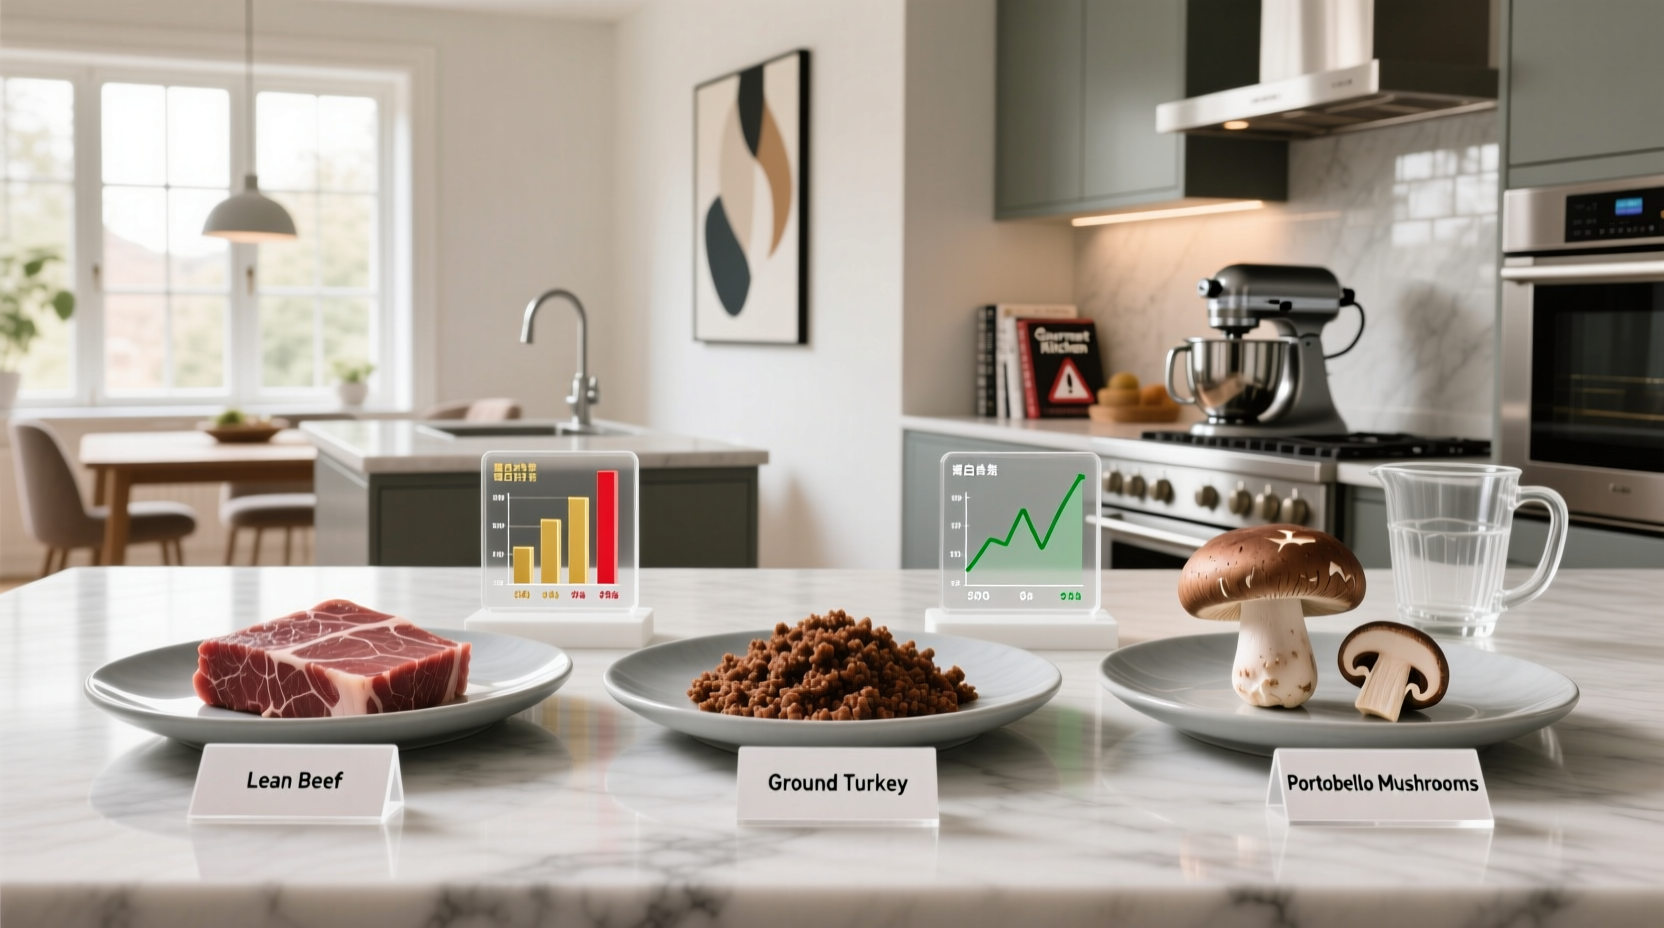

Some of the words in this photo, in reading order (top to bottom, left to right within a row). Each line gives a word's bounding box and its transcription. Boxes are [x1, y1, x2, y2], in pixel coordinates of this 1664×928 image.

[1040, 341, 1088, 354] Kitchen
[247, 771, 292, 789] Lean
[298, 771, 344, 789] Beef
[768, 773, 838, 791] Ground
[843, 773, 908, 795] Turkey
[1287, 774, 1374, 792] Portobello
[1378, 774, 1479, 792] Mushrooms
